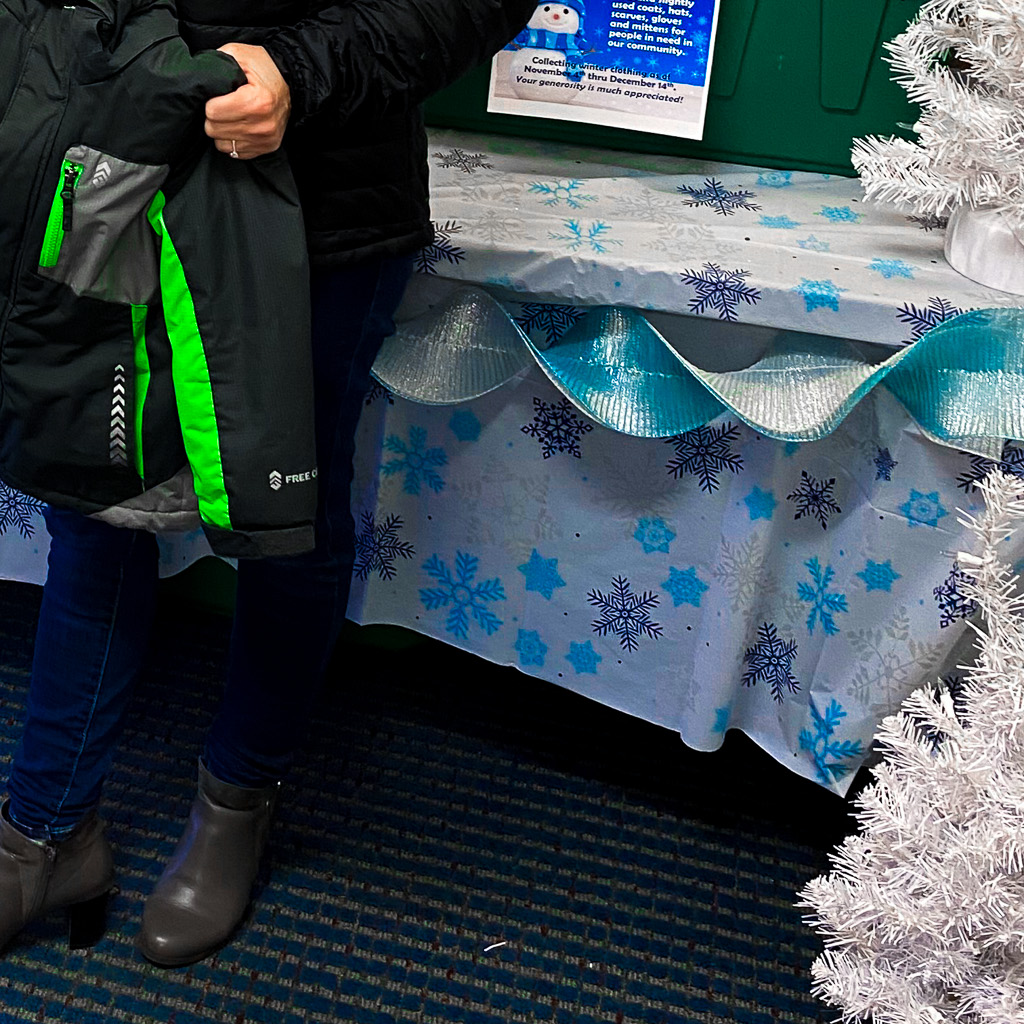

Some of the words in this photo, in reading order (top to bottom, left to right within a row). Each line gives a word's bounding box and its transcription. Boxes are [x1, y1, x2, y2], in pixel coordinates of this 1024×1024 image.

[611, 12, 648, 22] scarves,
[651, 15, 682, 25] gloves
[637, 5, 665, 14] coats,
[668, 7, 692, 18] hats,
[632, 23, 668, 33] mittens
[671, 27, 686, 35] for
[609, 31, 642, 40] people
[644, 33, 653, 41] in
[657, 37, 680, 45] need
[683, 38, 692, 46] in
[627, 42, 685, 56] community.
[532, 57, 576, 69] Collecting
[579, 62, 608, 72] winter
[611, 65, 647, 78] clothing
[524, 65, 572, 77] November
[588, 73, 608, 81] thru
[610, 76, 656, 88] December
[658, 82, 676, 91] 14th.
[516, 76, 537, 84] Your
[539, 79, 586, 91] generosity
[597, 86, 622, 95] much
[624, 90, 684, 104] appreciated!
[286, 472, 311, 483] FREE
